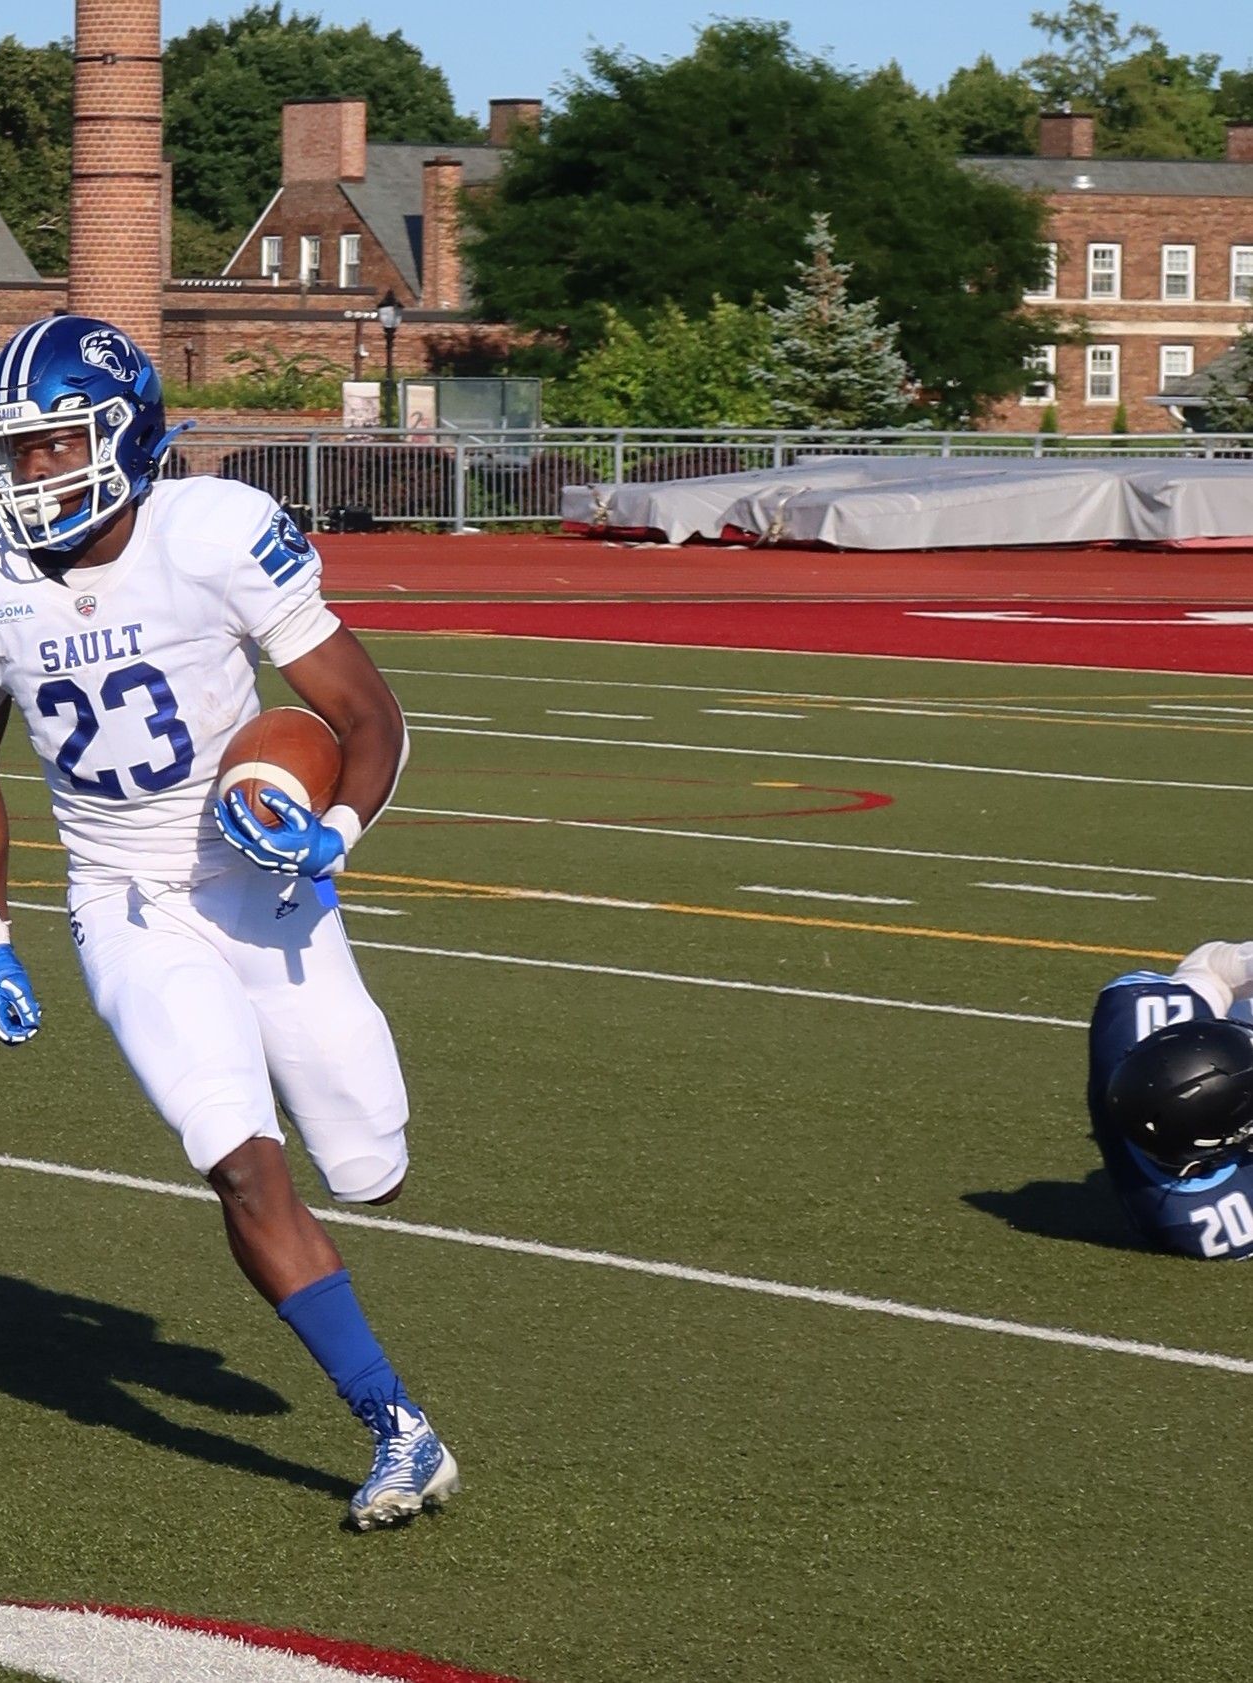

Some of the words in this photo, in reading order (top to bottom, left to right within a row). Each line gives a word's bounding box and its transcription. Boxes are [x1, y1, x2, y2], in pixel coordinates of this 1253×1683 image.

[39, 623, 142, 672] SAULT
[36, 661, 195, 800] 23
[1190, 1190, 1253, 1257] 20
